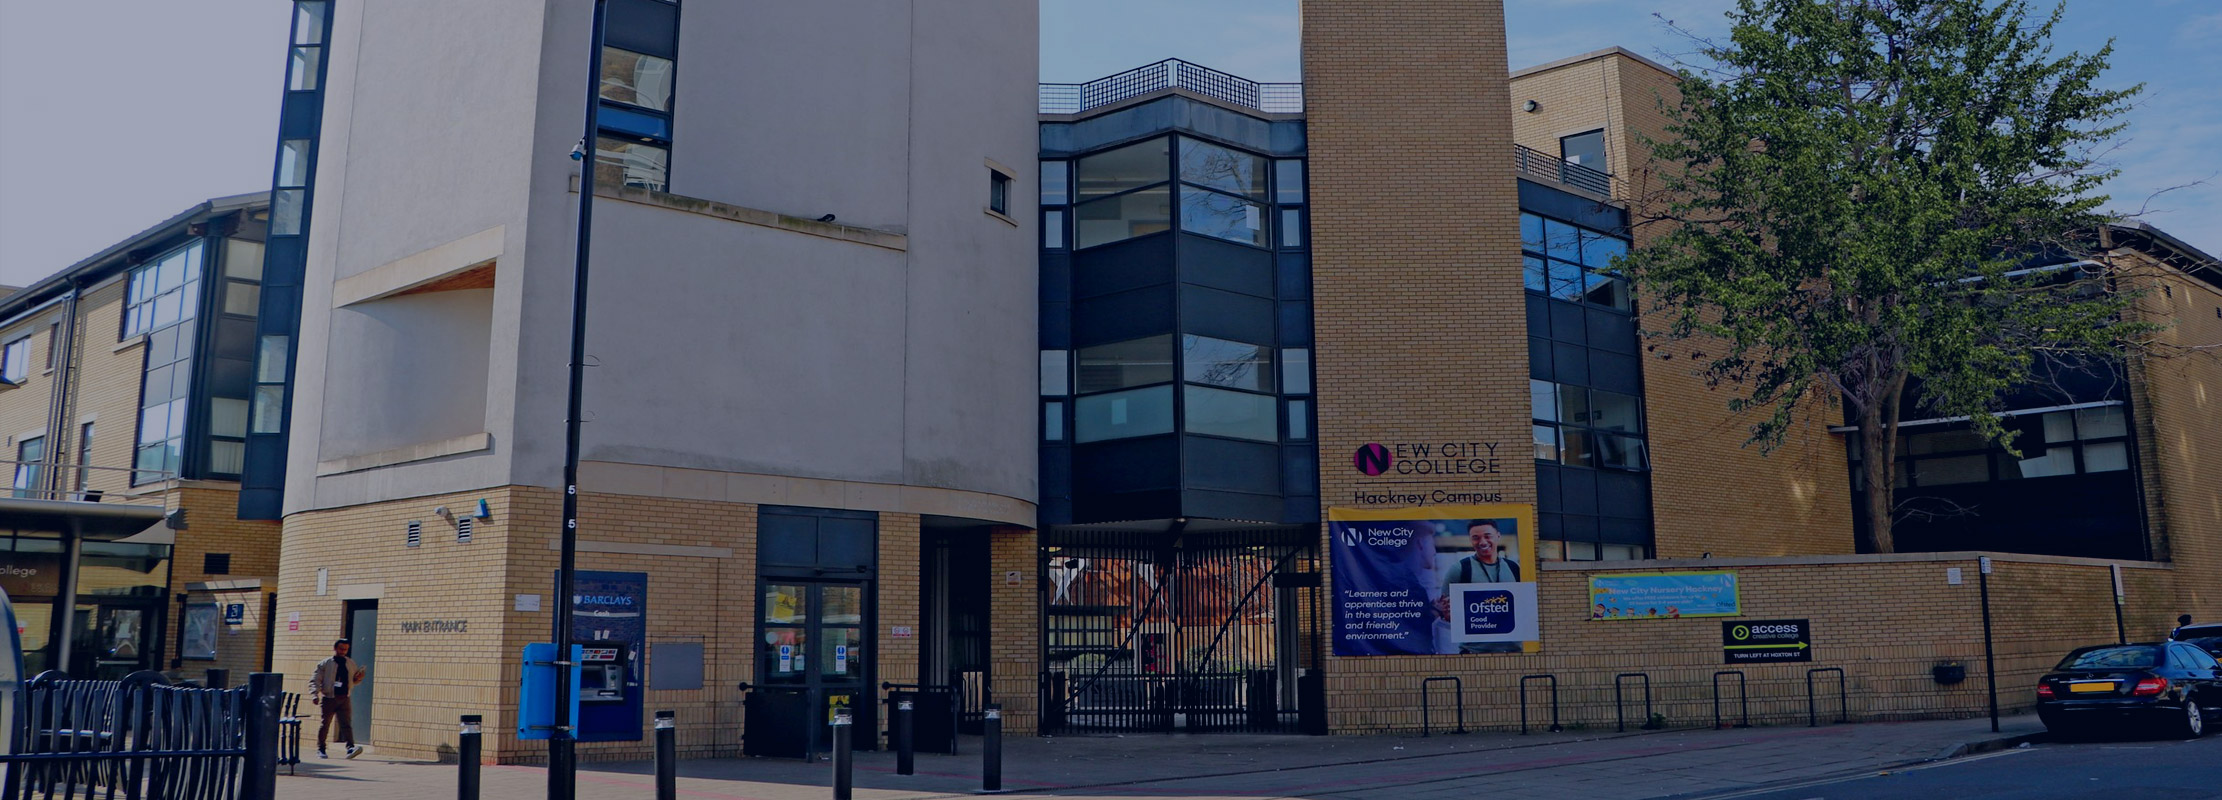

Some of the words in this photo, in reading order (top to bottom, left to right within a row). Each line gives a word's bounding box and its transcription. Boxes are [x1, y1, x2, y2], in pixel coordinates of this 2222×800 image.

[1441, 442, 1498, 458] CITY
[1396, 458, 1500, 475] COLLEGE
[567, 484, 576, 495] 5
[1354, 490, 1427, 507] Hackney
[1431, 489, 1502, 506] Campus
[567, 518, 576, 529] 5
[1368, 527, 1391, 537] New
[1392, 527, 1414, 538] City
[1367, 536, 1408, 547] College
[1389, 589, 1409, 598] and
[583, 595, 632, 606] BARCLAYS
[1344, 600, 1397, 610] apprentices
[1398, 599, 1424, 608] thrive
[1470, 601, 1509, 614] Ofsted
[1344, 610, 1353, 619] in
[1355, 610, 1371, 619] the
[1372, 610, 1422, 620] supportive
[1345, 621, 1364, 630] and
[1365, 620, 1400, 631] friendly
[1470, 622, 1498, 630] Provider
[1751, 624, 1799, 634] access
[1752, 632, 1776, 640] creative
[1776, 632, 1800, 640] college
